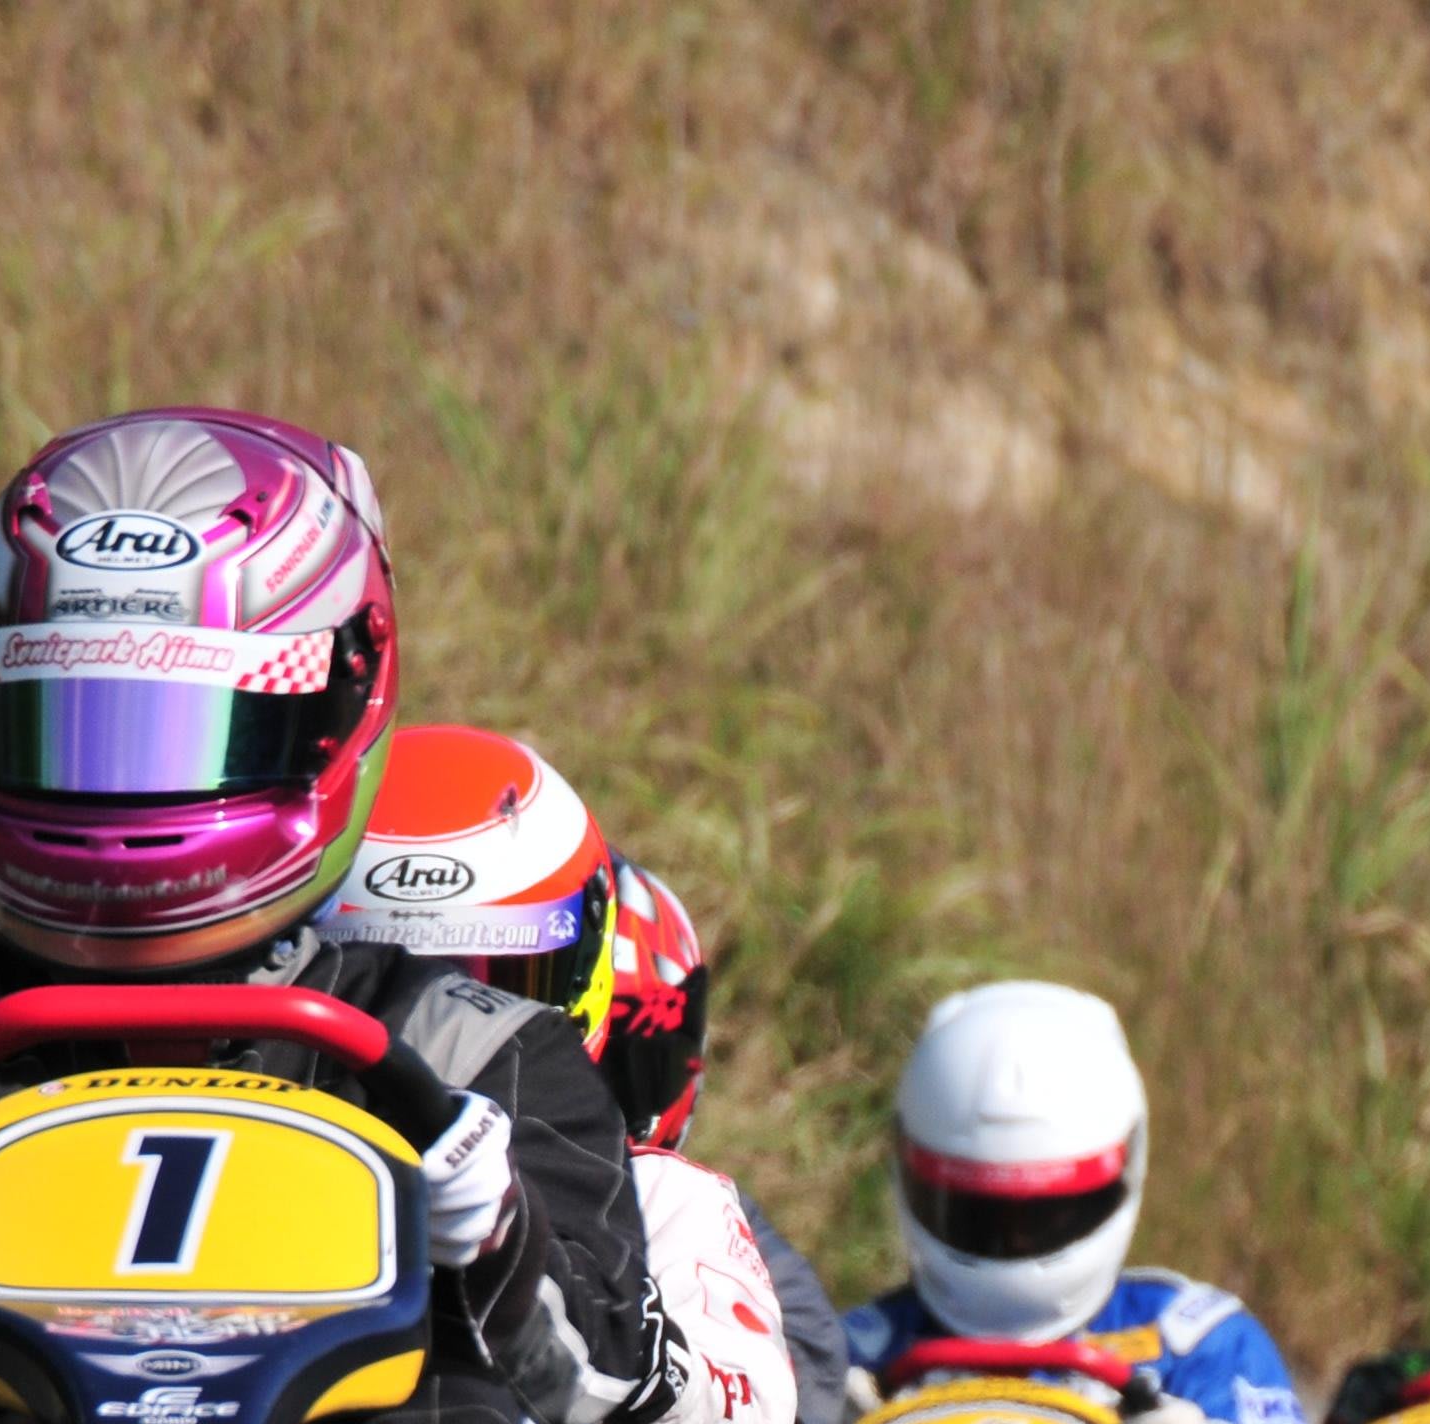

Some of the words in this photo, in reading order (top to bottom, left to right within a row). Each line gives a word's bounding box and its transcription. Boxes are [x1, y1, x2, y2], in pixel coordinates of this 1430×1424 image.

[66, 519, 185, 556] Arai
[2, 630, 136, 671] Sonicpark
[135, 631, 235, 673] Ajimu
[374, 858, 462, 889] Arai
[85, 1077, 313, 1093] DUNLOP
[445, 1115, 494, 1169] SPORTS
[117, 1130, 231, 1272] 1
[97, 1401, 241, 1418] EDIFICE
